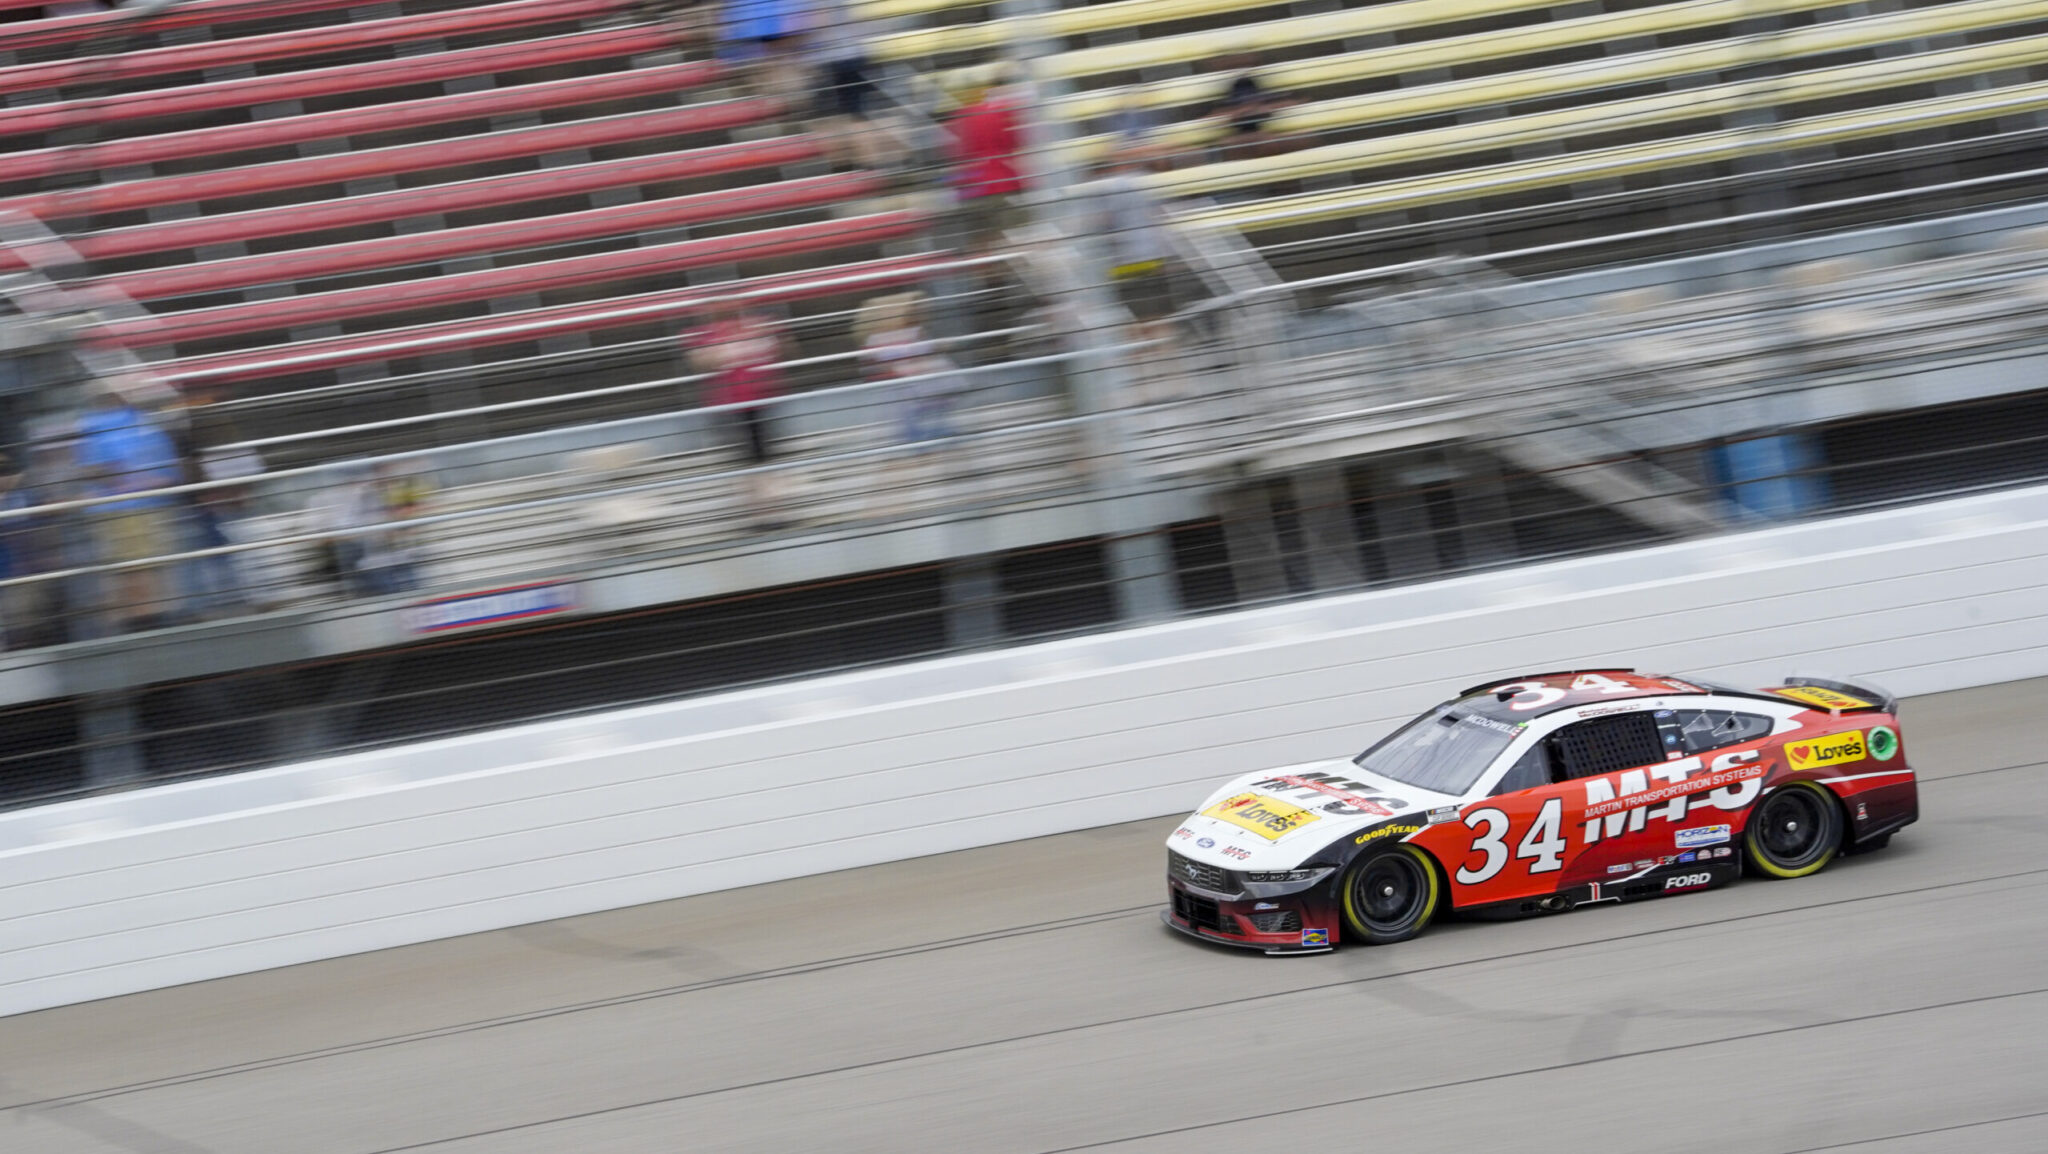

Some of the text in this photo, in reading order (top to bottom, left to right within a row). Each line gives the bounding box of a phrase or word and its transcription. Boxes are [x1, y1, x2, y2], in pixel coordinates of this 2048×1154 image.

[1488, 674, 1637, 711] 34
[1583, 750, 1763, 844] MTS
[1584, 765, 1762, 818] MARTIN TRANSPORTATION SYSTEMS
[1355, 824, 1420, 844] GOODYEAR
[1455, 797, 1568, 886] 34
[1665, 872, 1712, 889] FORD
